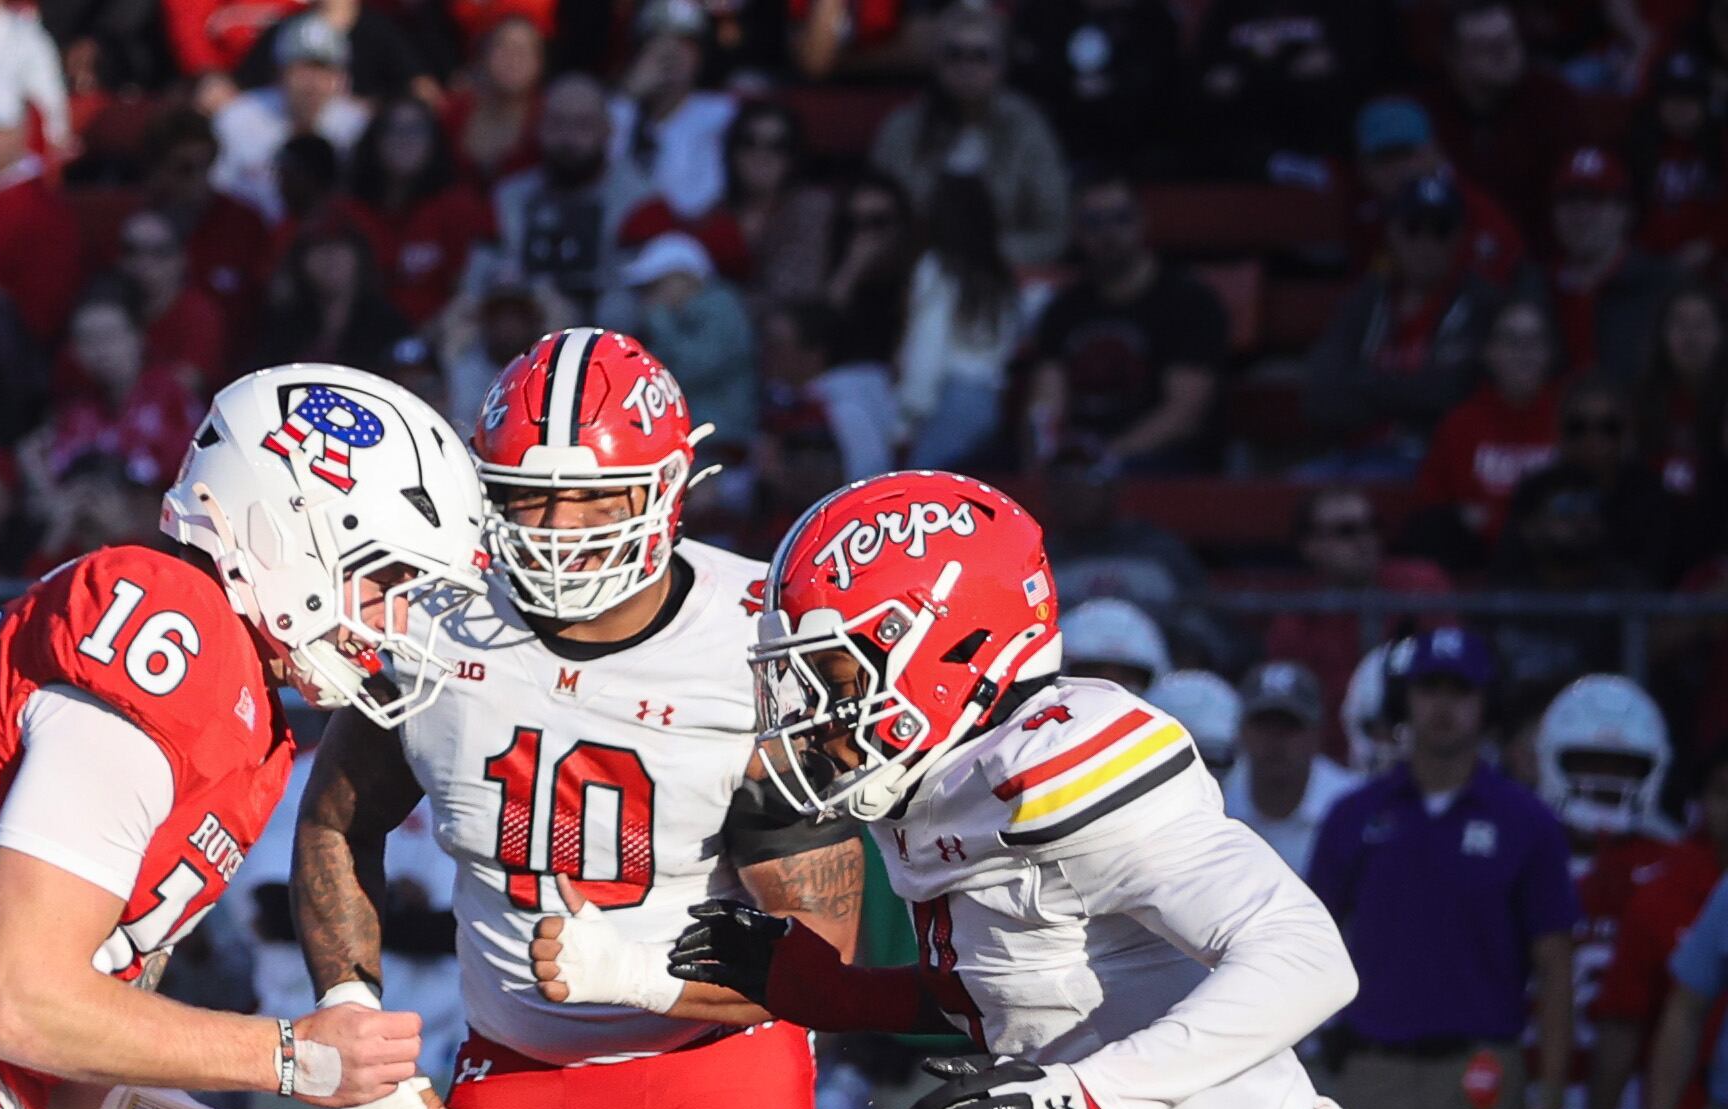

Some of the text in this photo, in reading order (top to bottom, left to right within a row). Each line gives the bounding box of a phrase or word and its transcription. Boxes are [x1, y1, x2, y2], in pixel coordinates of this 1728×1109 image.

[260, 385, 385, 495] R
[813, 501, 977, 591] Terps
[77, 577, 202, 697] 16
[555, 666, 582, 698] M
[483, 725, 656, 913] 10
